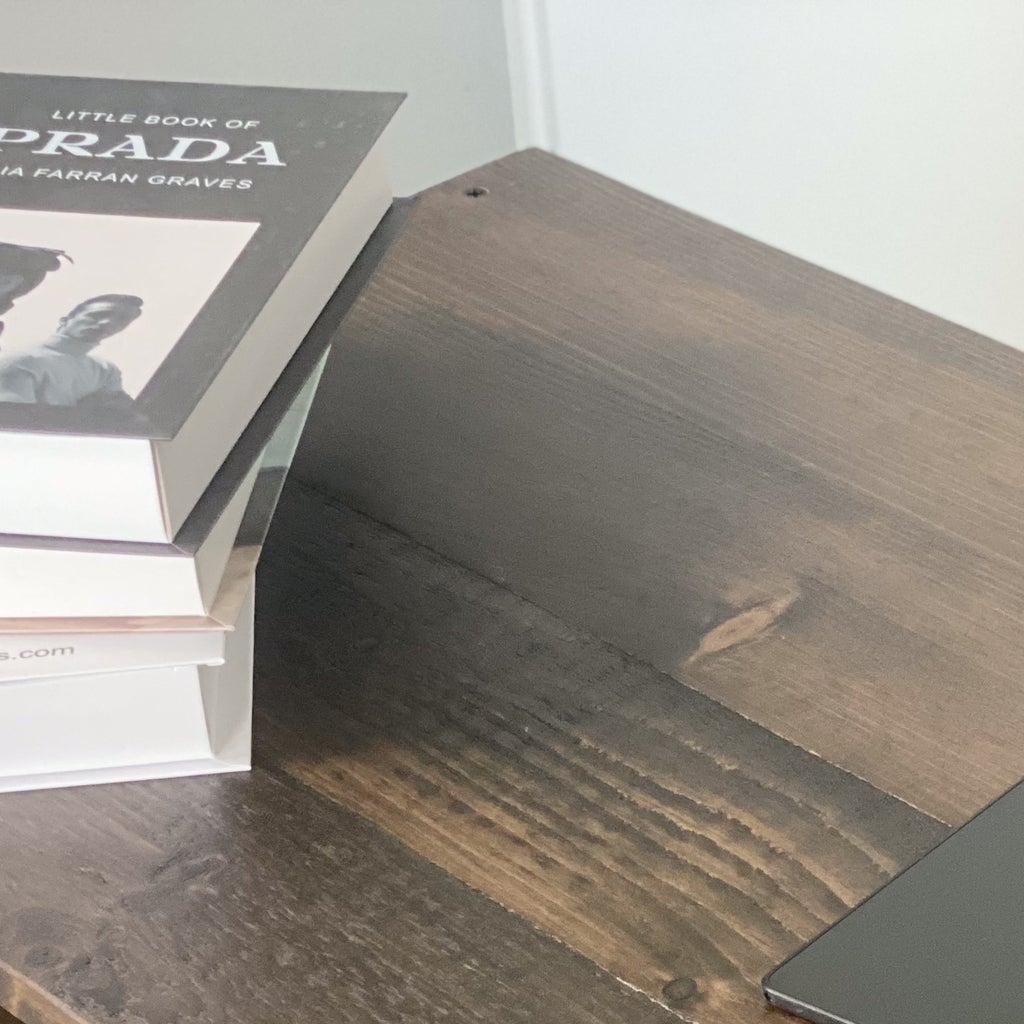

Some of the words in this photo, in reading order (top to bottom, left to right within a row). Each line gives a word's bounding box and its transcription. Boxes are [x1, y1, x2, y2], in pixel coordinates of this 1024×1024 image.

[52, 110, 136, 123] LITTLE
[144, 115, 216, 127] BOOK
[225, 120, 260, 130] OF
[0, 128, 286, 167] PRADA
[34, 168, 138, 183] FARRAN
[148, 175, 253, 190] GRAVES
